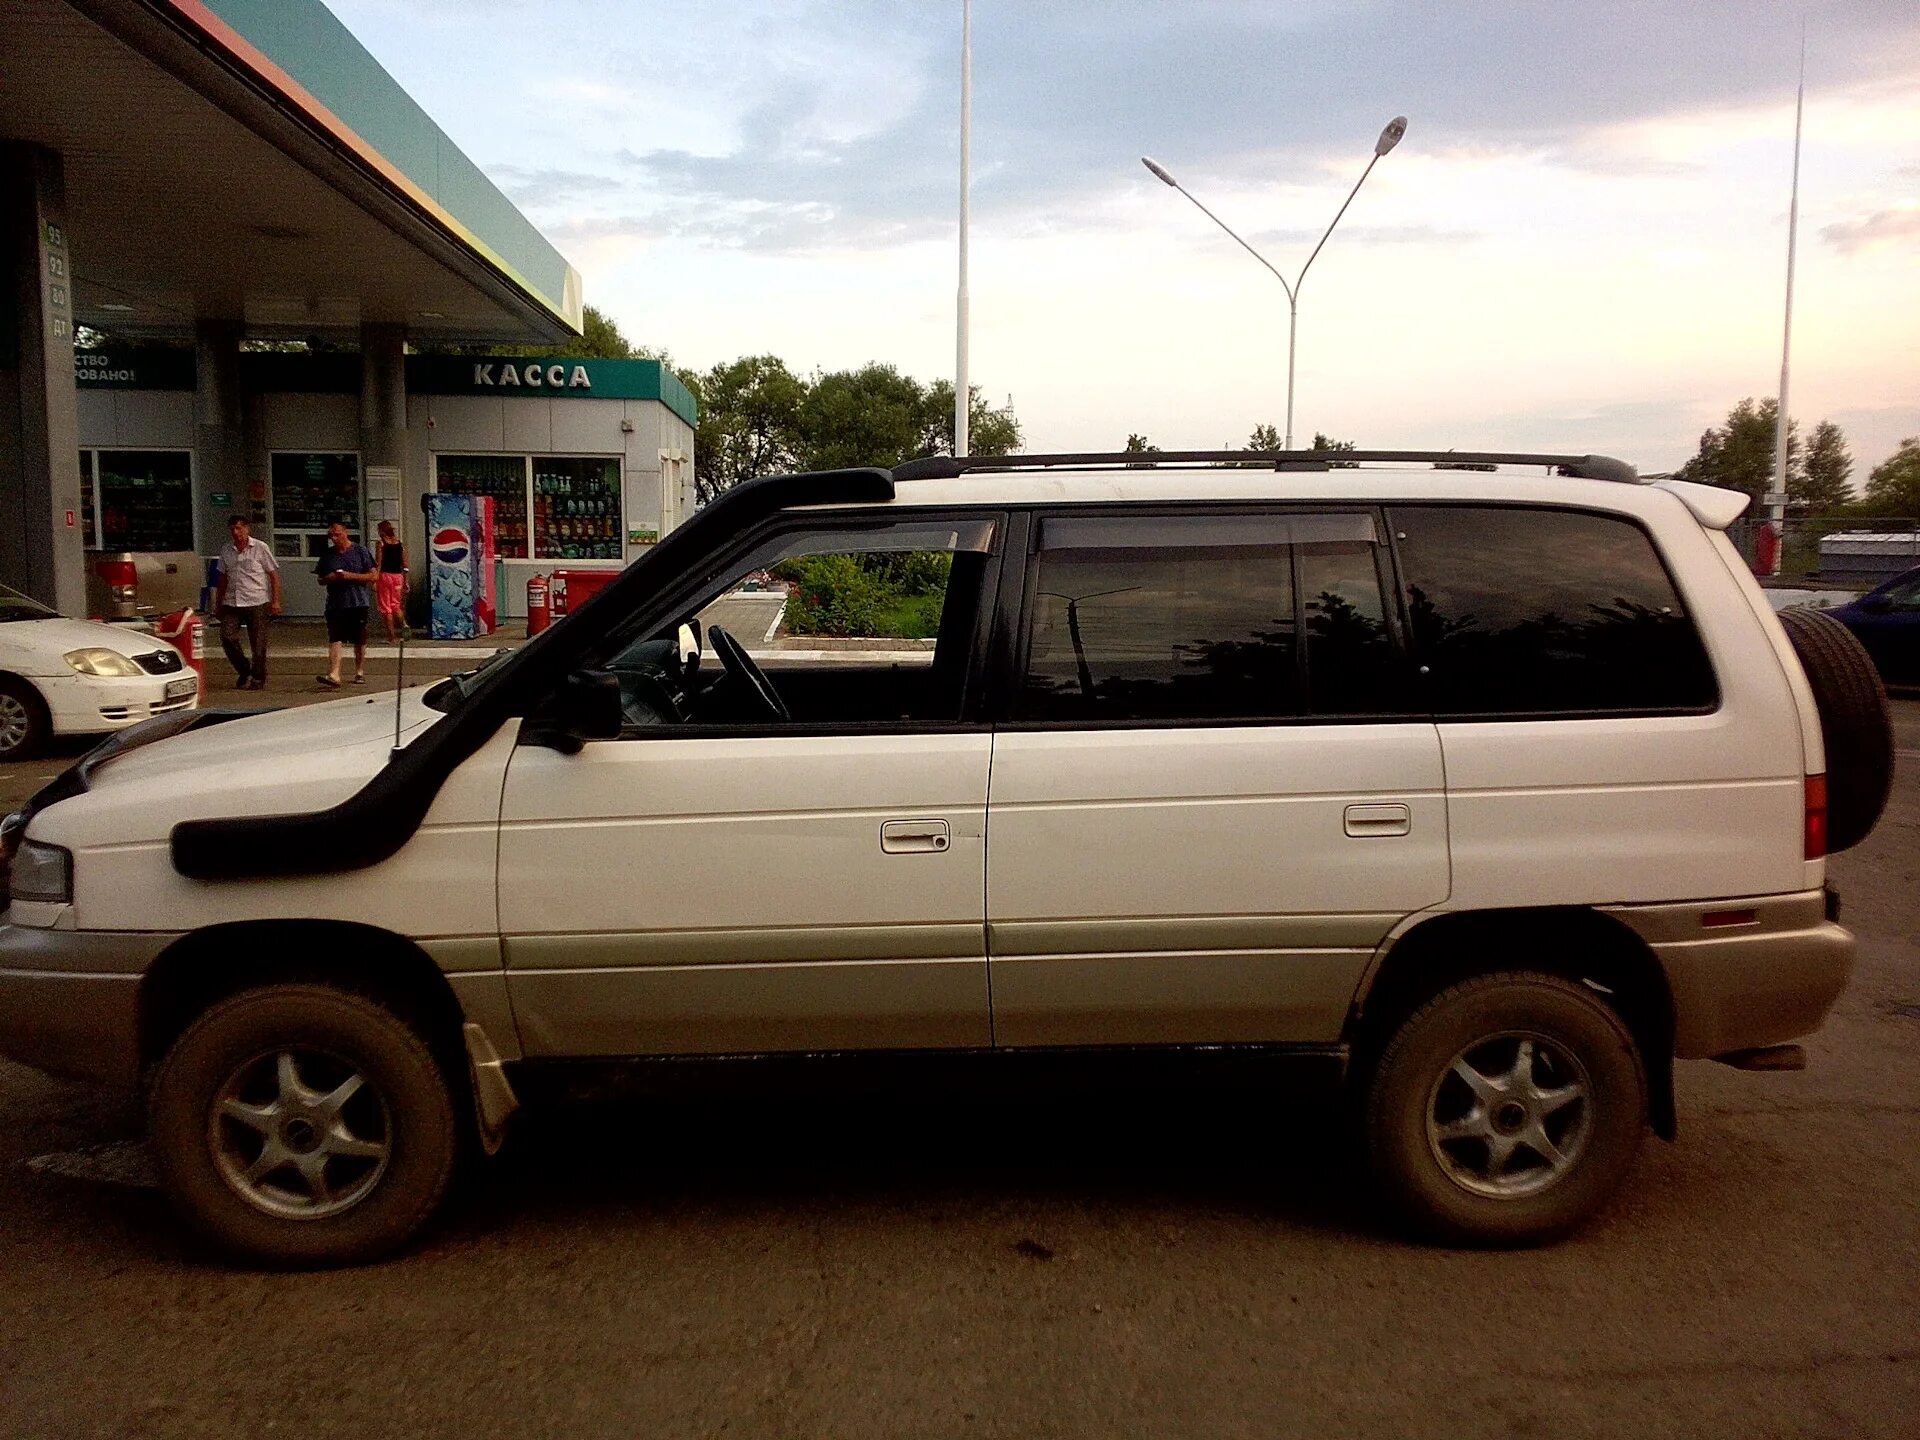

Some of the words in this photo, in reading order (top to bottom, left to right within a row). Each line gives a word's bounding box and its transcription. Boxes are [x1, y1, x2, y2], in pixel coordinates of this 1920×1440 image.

[48, 225, 61, 245] 95
[50, 256, 63, 276] 92
[54, 319, 67, 337] ДТ
[474, 363, 591, 388] КАССА
